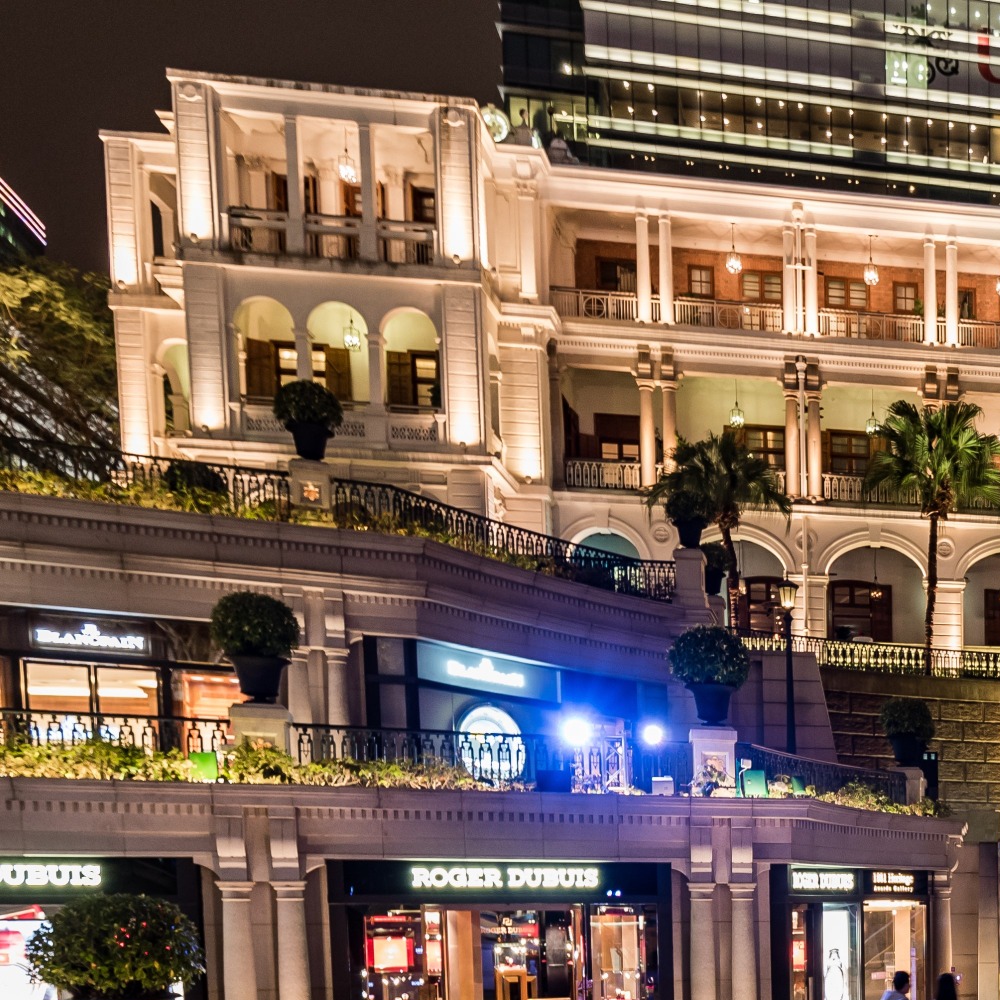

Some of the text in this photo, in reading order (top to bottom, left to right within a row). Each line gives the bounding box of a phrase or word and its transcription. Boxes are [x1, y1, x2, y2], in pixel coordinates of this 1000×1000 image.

[0, 864, 102, 886] UBUIS
[411, 867, 599, 888] ROGER DUBUIS
